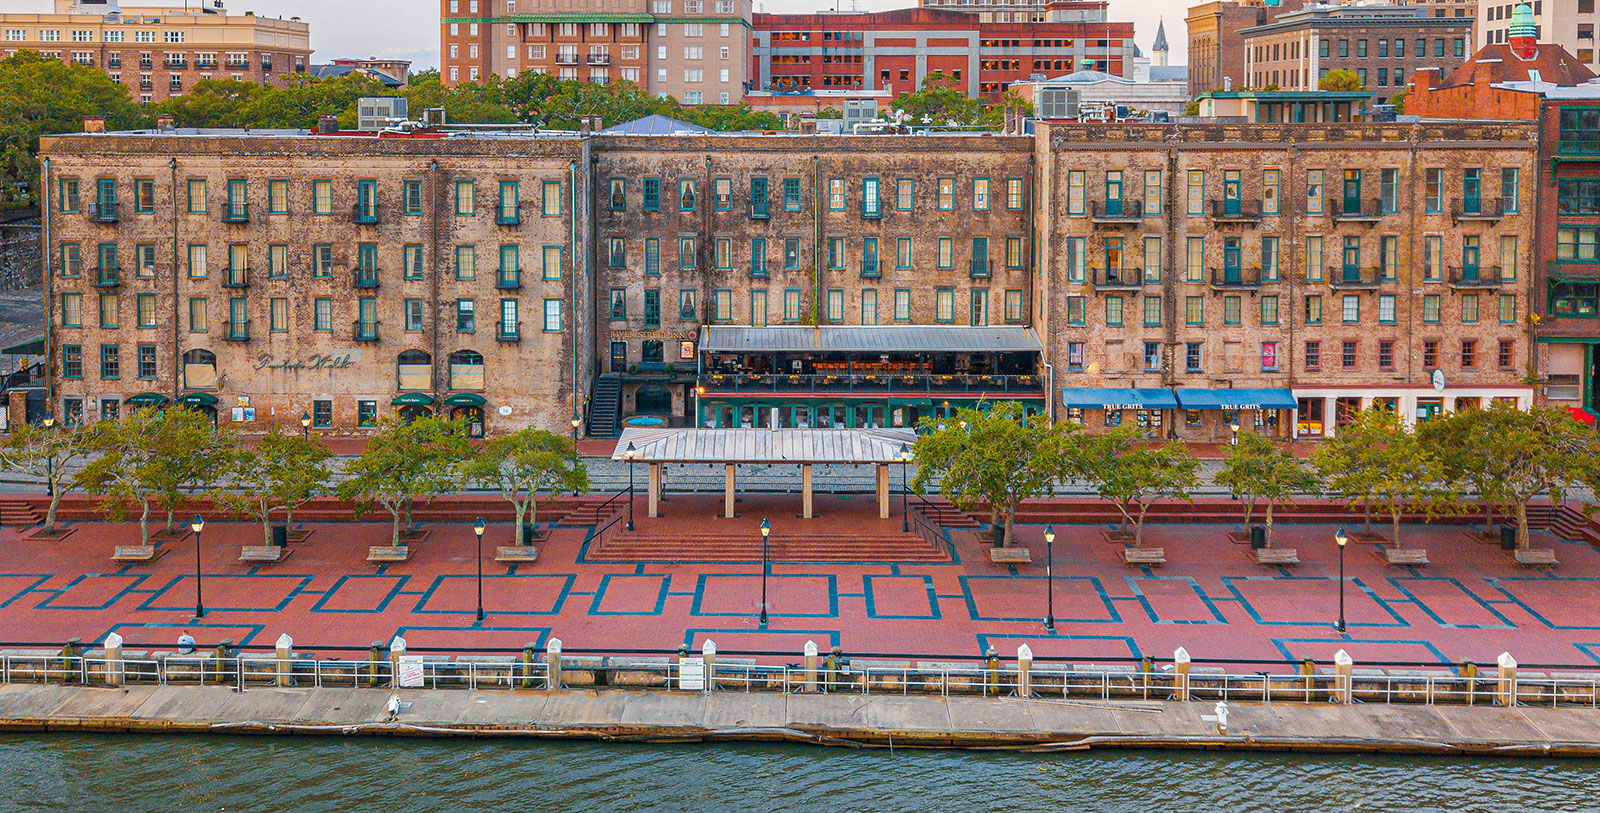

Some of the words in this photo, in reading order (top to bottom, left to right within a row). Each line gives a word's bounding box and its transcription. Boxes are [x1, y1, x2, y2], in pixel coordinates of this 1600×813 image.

[610, 330, 634, 338] RIVER
[637, 330, 667, 339] STREET
[669, 331, 685, 339] INN
